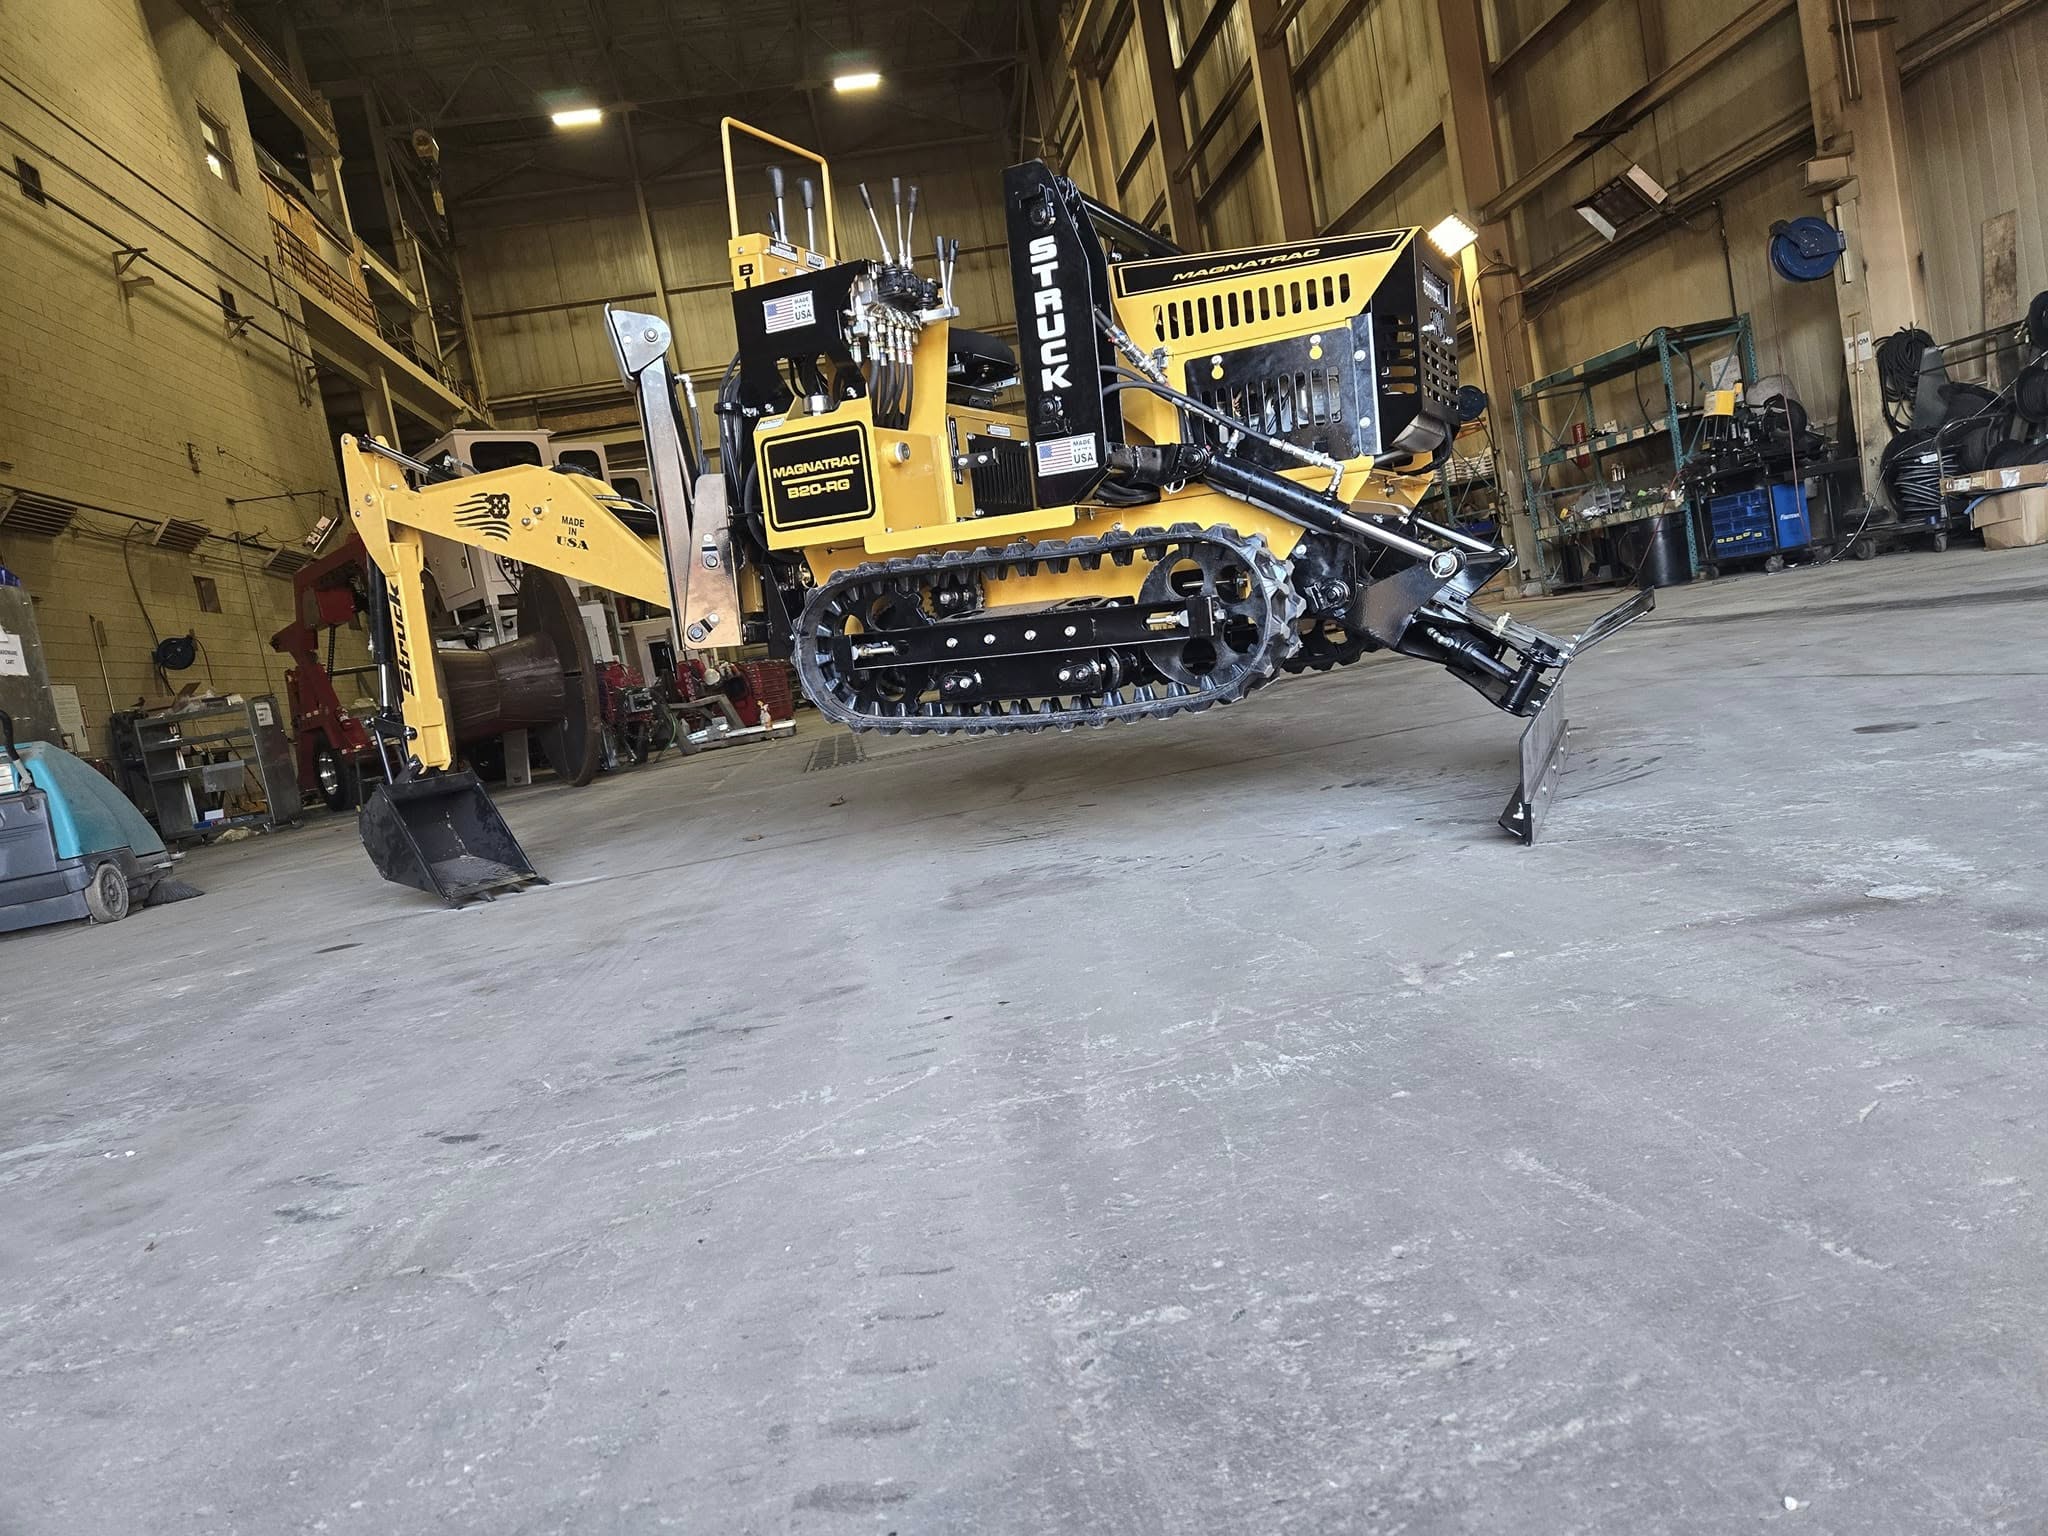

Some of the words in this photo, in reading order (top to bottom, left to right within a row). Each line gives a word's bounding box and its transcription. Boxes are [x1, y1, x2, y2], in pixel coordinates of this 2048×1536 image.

[1171, 248, 1321, 281] MAGNATRAC
[795, 309, 812, 321] USA
[1028, 234, 1073, 393] STRUCK
[1072, 438, 1091, 446] MADE
[1073, 452, 1094, 464] USA
[772, 453, 860, 479] MAGNATRAC
[561, 515, 585, 528] MADE
[568, 527, 577, 536] IN
[556, 535, 589, 551] USA
[388, 580, 415, 697] Struck
